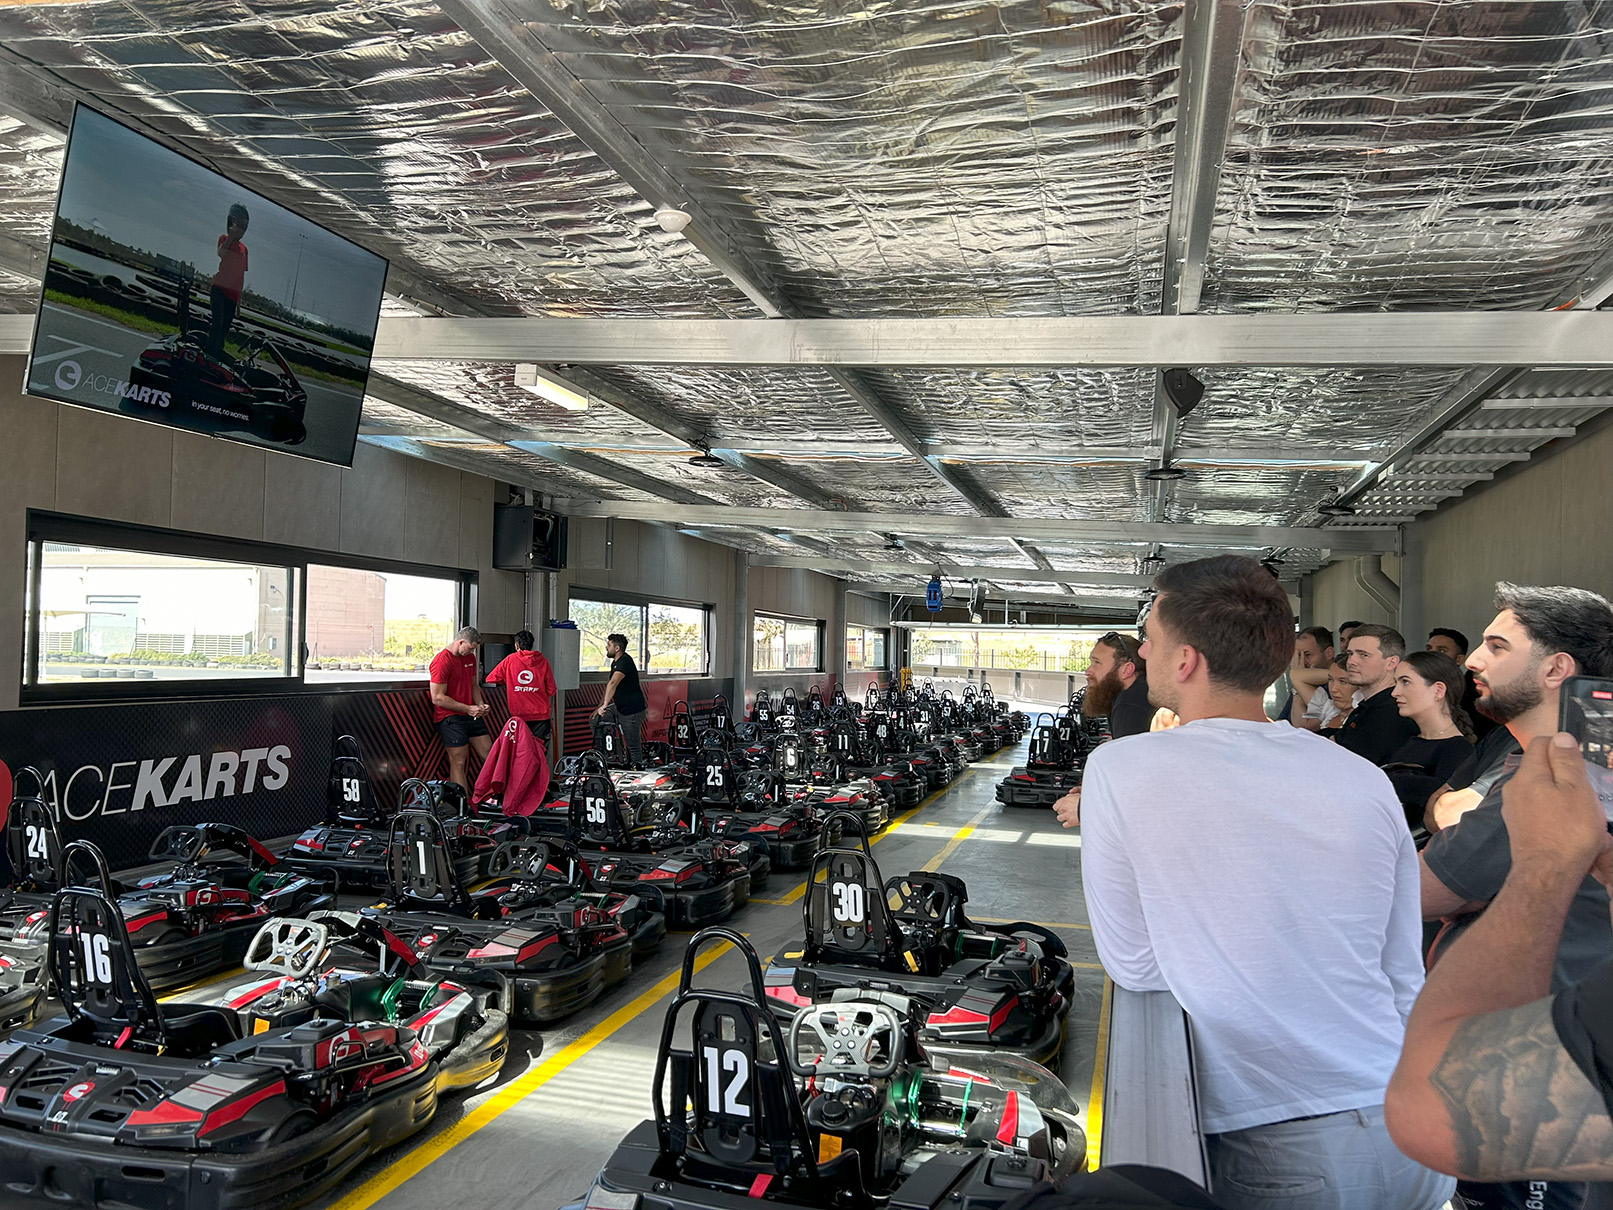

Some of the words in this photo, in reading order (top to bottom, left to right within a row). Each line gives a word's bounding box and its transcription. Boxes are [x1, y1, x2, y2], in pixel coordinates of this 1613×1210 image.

[81, 373, 172, 408] ACEKARTS
[835, 696, 843, 706] 13
[759, 709, 769, 721] 55
[786, 704, 795, 715] 54
[920, 710, 929, 722] 31
[717, 715, 726, 728] 17
[677, 724, 689, 739] 32
[876, 724, 887, 738] 48
[1059, 727, 1071, 741] 27
[605, 735, 612, 751] 8
[837, 734, 848, 750] 11
[1042, 738, 1049, 753] 7
[786, 749, 795, 766] 6
[37, 744, 291, 823] ACEKARTS
[705, 764, 723, 787] 25
[342, 778, 361, 803] 58
[585, 797, 606, 824] 56
[26, 825, 48, 860] 24
[416, 841, 426, 875] 1
[832, 881, 864, 924] 30
[80, 932, 113, 984] 16
[704, 1046, 751, 1118] 12
